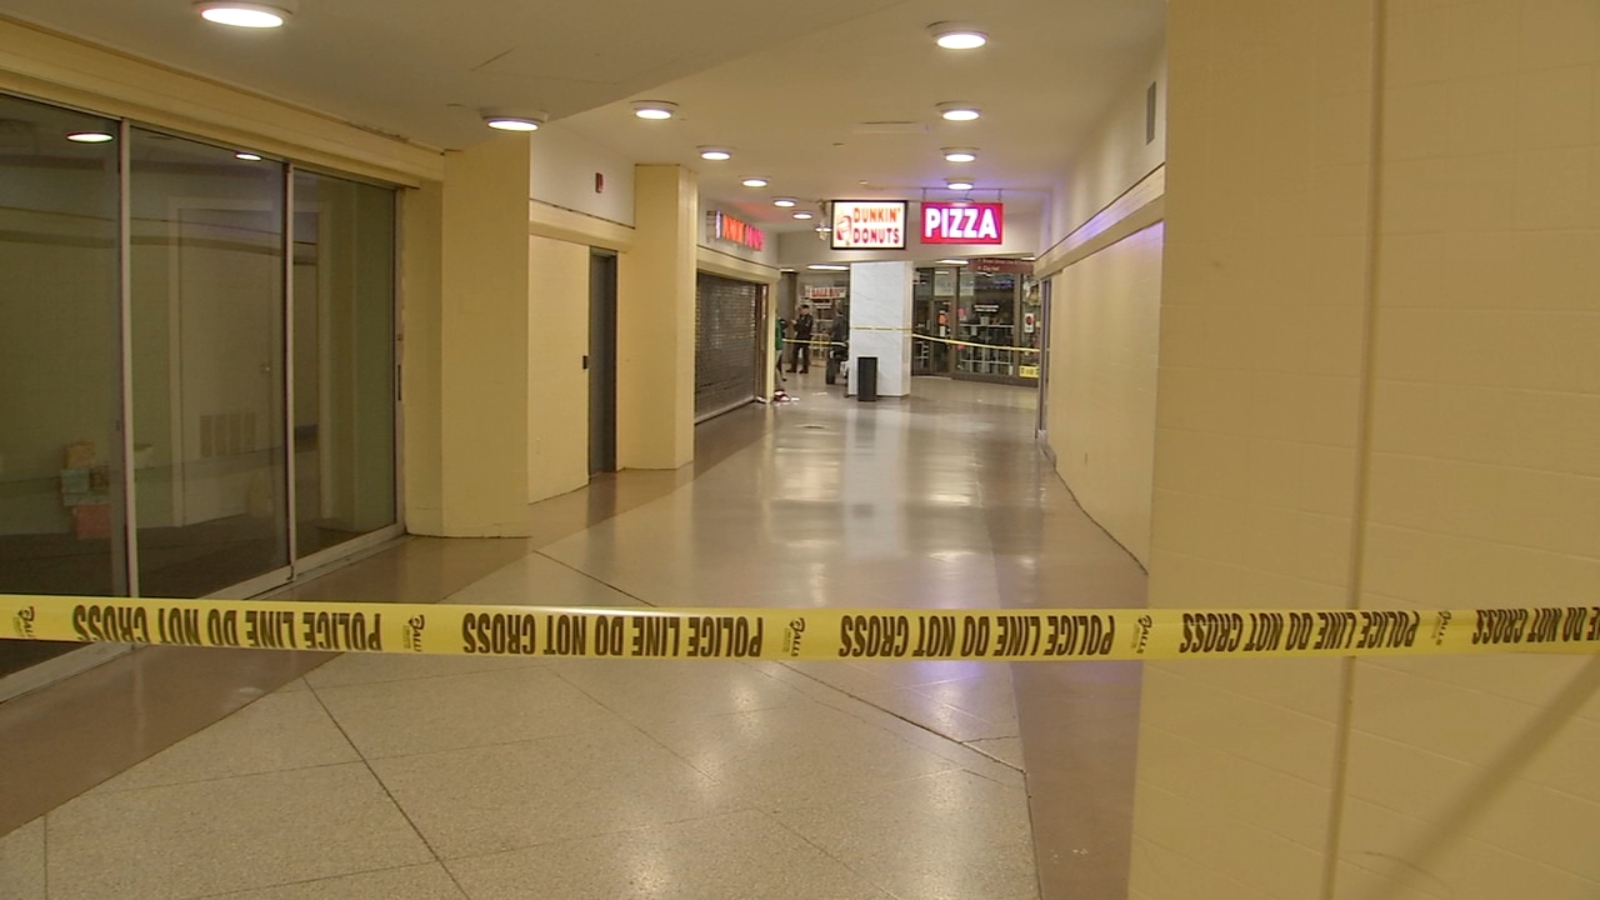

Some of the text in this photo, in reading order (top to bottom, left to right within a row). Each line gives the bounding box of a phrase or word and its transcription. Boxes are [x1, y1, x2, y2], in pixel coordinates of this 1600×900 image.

[853, 207, 901, 223] DUNKIN'
[924, 207, 998, 239] PIZZA
[853, 227, 900, 244] DONUTS
[72, 604, 151, 643] CROSS
[158, 607, 200, 645] NOT
[207, 608, 240, 646] DO
[245, 610, 298, 648] LINE
[302, 611, 382, 650] POLICE
[462, 612, 536, 655] CROSS
[543, 614, 587, 656] NOT
[594, 615, 624, 656] DO
[631, 616, 681, 657] LINE
[686, 616, 763, 657] POLICE
[838, 614, 909, 657] CROSS
[912, 615, 956, 657] NOT
[960, 615, 990, 657] DO
[993, 615, 1041, 657] LINE
[1043, 615, 1115, 657] POLICE
[1179, 612, 1244, 653] CROSS
[1243, 612, 1285, 652] NOT
[1285, 612, 1314, 651] DO
[1313, 611, 1357, 650] LINE
[1358, 610, 1421, 649] POLICE
[1472, 610, 1529, 645] CROSS
[1527, 608, 1563, 643] NOT
[1562, 607, 1588, 642] DO
